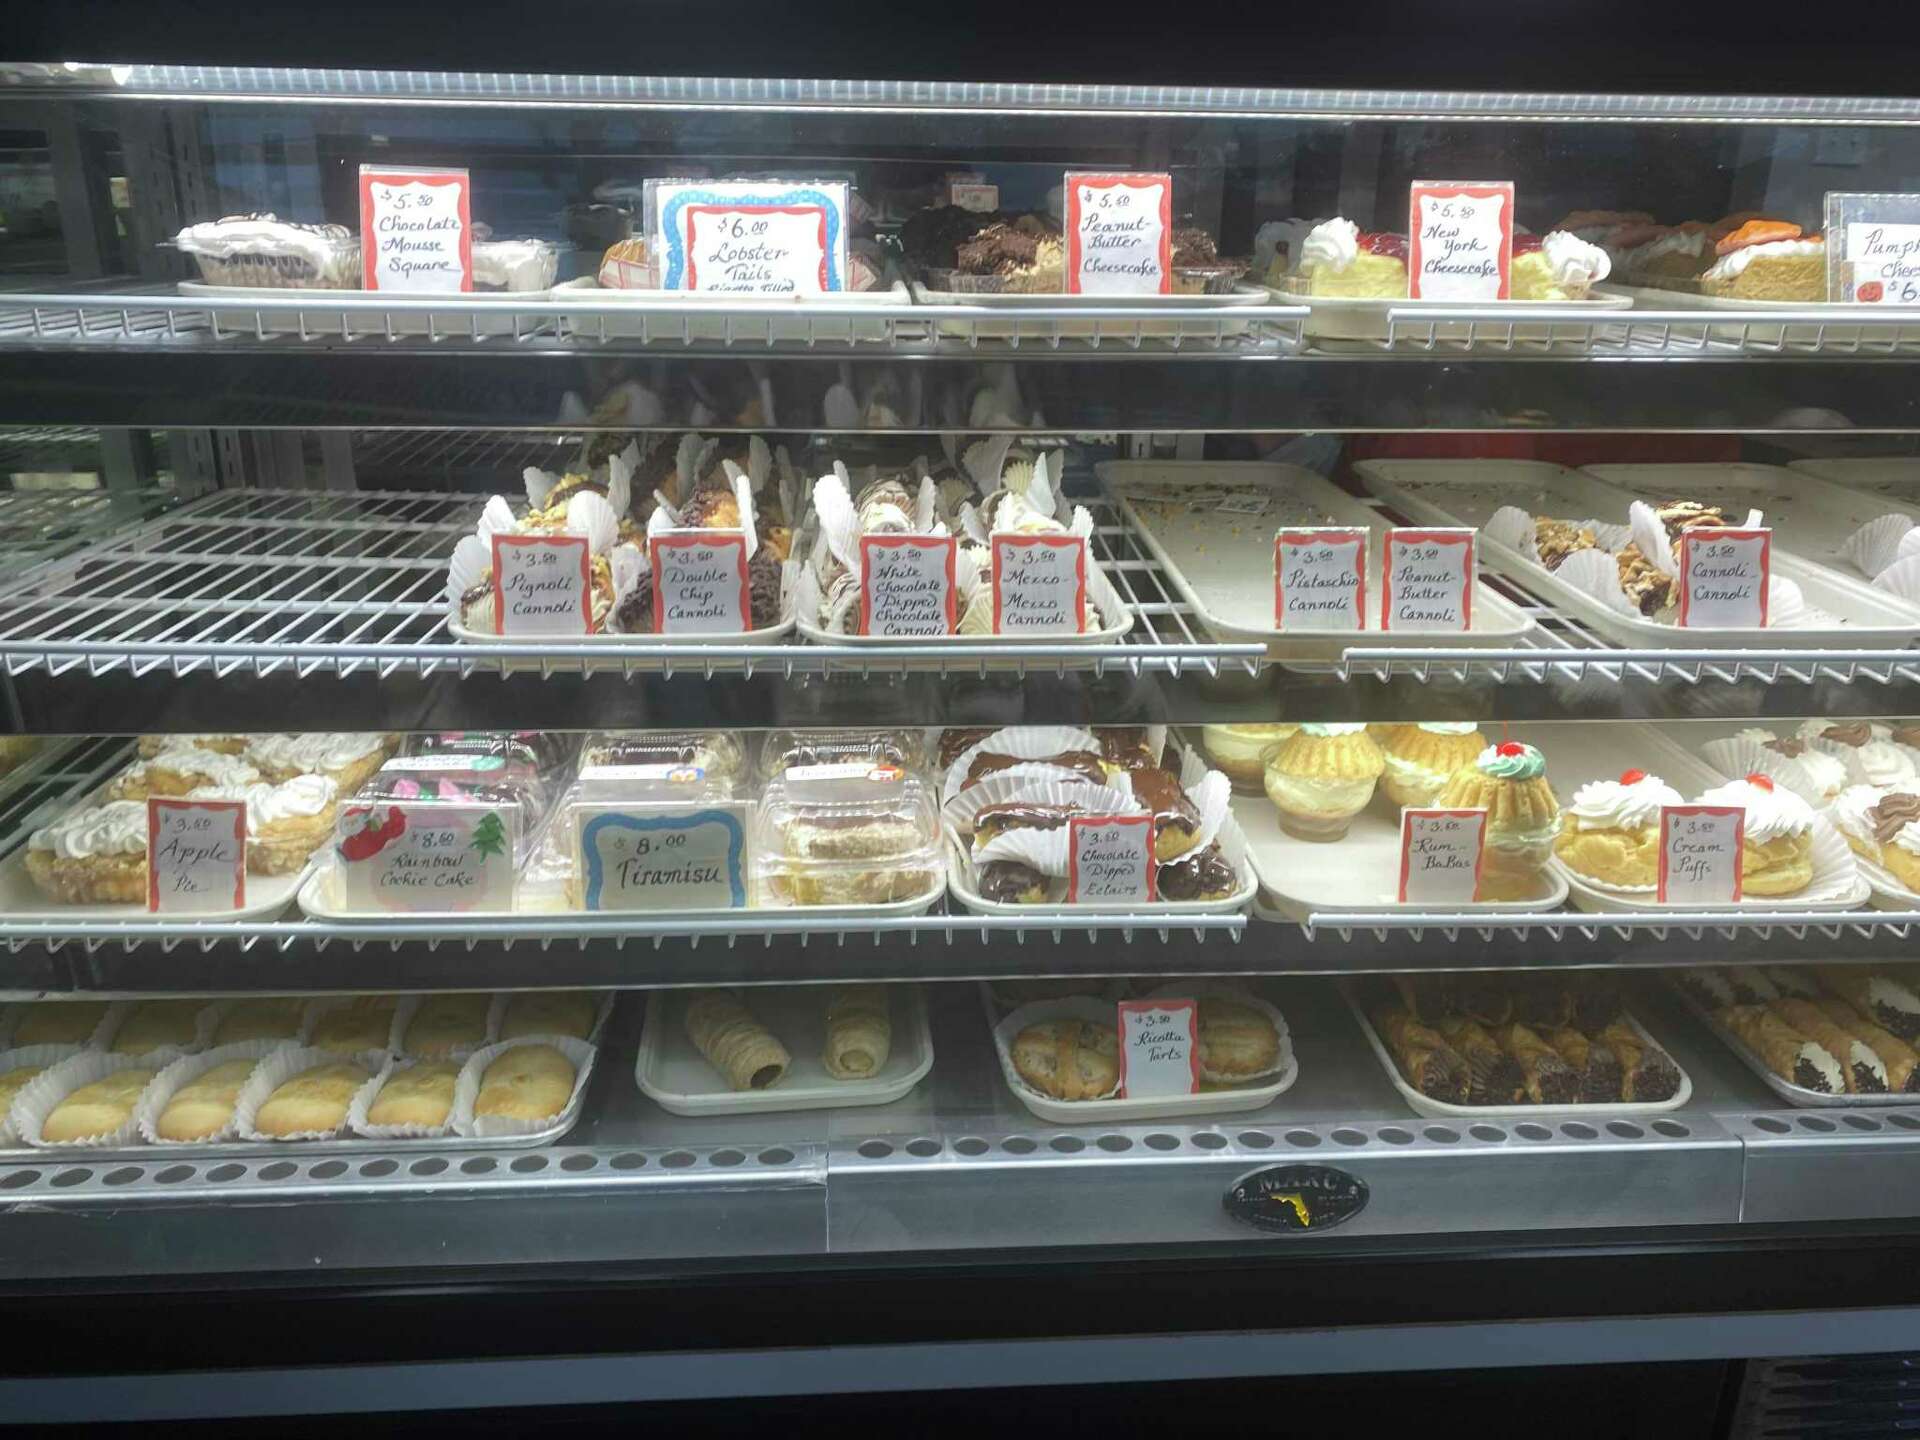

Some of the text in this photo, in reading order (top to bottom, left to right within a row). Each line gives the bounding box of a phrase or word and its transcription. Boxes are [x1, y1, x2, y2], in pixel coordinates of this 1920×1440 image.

[379, 215, 461, 232] Chocolate
[1423, 223, 1460, 239] New
[382, 236, 445, 254] Mousse
[1088, 234, 1142, 250] Butter
[1441, 238, 1488, 261] York
[709, 242, 789, 263] Lobster
[389, 257, 461, 279] Square
[724, 263, 772, 282] Tails
[1084, 258, 1158, 276] Cheesecake
[1425, 259, 1499, 278] Cheesecake
[665, 567, 728, 585] Double
[874, 563, 922, 579] White
[505, 573, 574, 599] Pignoli
[876, 580, 941, 593] Chocolate
[1399, 585, 1448, 601] Butter
[1694, 584, 1752, 601] Cannoli
[680, 586, 714, 607] Chip
[875, 593, 938, 612] Dipped
[1289, 596, 1349, 611] Cannoli
[512, 599, 576, 616] Cannoli
[668, 604, 728, 620] Cannoli
[875, 609, 941, 622] Chocolate
[1400, 605, 1456, 622] Cannoli
[1006, 610, 1067, 625] Cannoli
[883, 622, 945, 636] Cannoli
[159, 838, 235, 865] Apple
[1672, 836, 1725, 854] Cream
[392, 853, 465, 869] Rainbow
[1081, 849, 1140, 863] Chocolate
[616, 857, 723, 890] Tiramisu
[1086, 862, 1136, 881] Dipped
[1672, 855, 1713, 882] Puffs
[172, 871, 209, 893] Pie
[380, 871, 475, 888] Cookie Cake
[1084, 882, 1138, 897] Eclairs
[1134, 1031, 1185, 1047] Ricotta
[1148, 1046, 1183, 1062] Tarts
